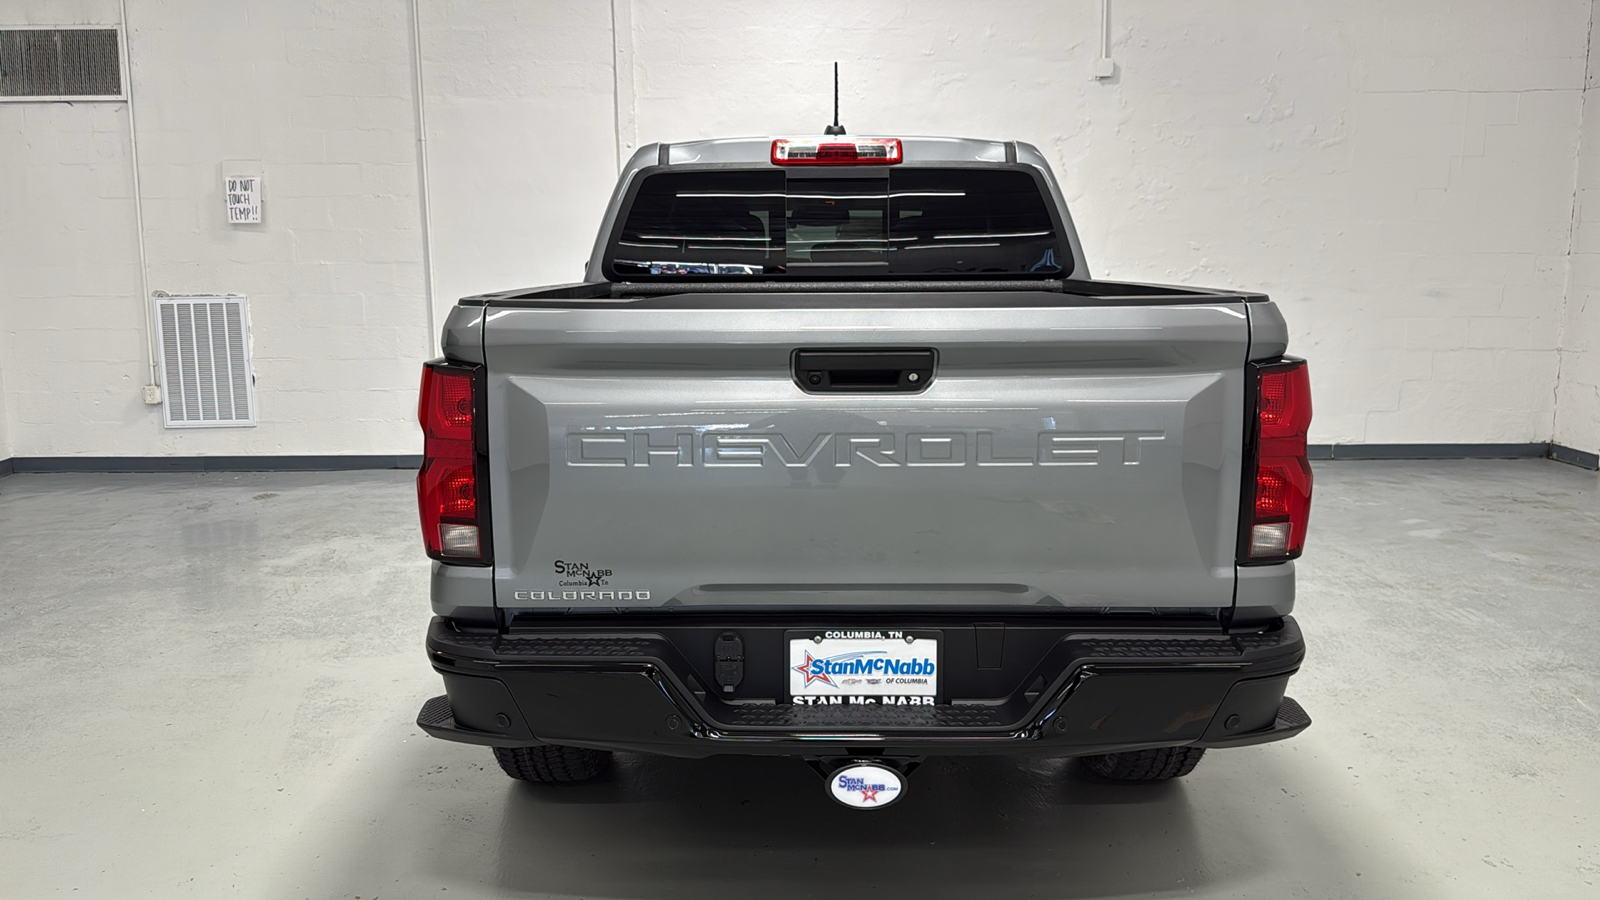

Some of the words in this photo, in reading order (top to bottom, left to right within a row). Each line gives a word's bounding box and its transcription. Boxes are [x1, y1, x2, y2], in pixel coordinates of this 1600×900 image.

[228, 179, 237, 192] DO
[240, 179, 255, 192] NOT
[228, 193, 250, 205] TOUCH
[229, 205, 258, 220] TEMP!!
[566, 431, 1166, 468] CHEVROLET
[554, 560, 589, 574] STAN
[514, 590, 651, 600] COLORADO
[825, 631, 886, 640] COLUMBIA,
[888, 631, 903, 639] TN
[811, 658, 935, 675] StanMcNabb
[792, 696, 843, 705] STAN
[883, 696, 935, 706] NABB
[838, 775, 864, 788] STAN
